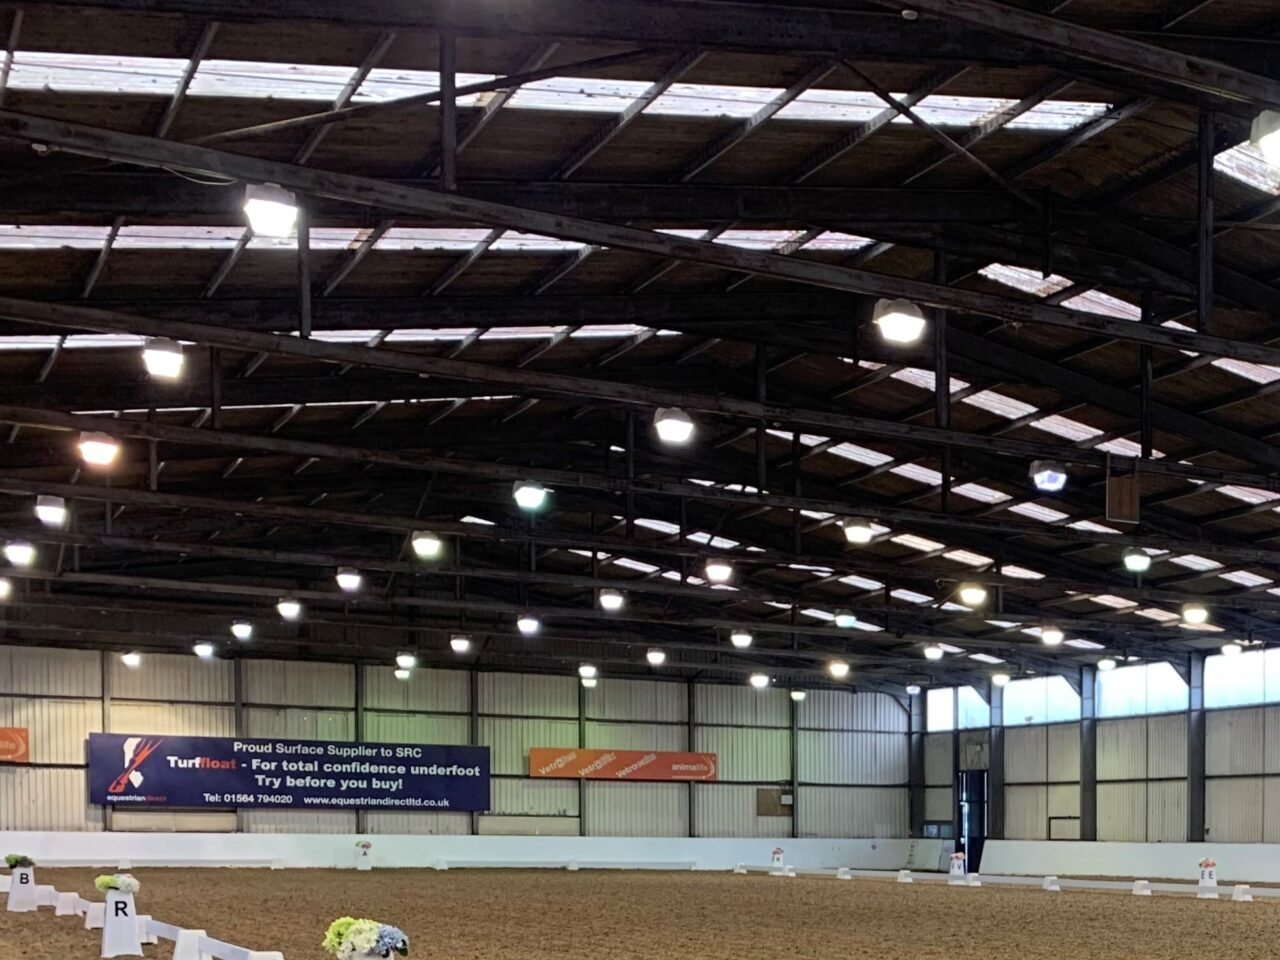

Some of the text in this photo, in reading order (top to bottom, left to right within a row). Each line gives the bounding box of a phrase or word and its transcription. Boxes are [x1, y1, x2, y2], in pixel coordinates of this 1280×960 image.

[233, 741, 422, 758] Proud Surface Supplier to SRC
[166, 755, 237, 770] Turffloat
[251, 758, 278, 771] For
[281, 760, 319, 772] total
[323, 761, 407, 774] confidence
[410, 764, 481, 777] underfoot
[254, 774, 403, 791] Try before you buy!
[203, 793, 450, 807] Tel: 01564 794020 www.equestriandirectltd.co.uk
[20, 872, 30, 885] B
[114, 900, 129, 917] R
